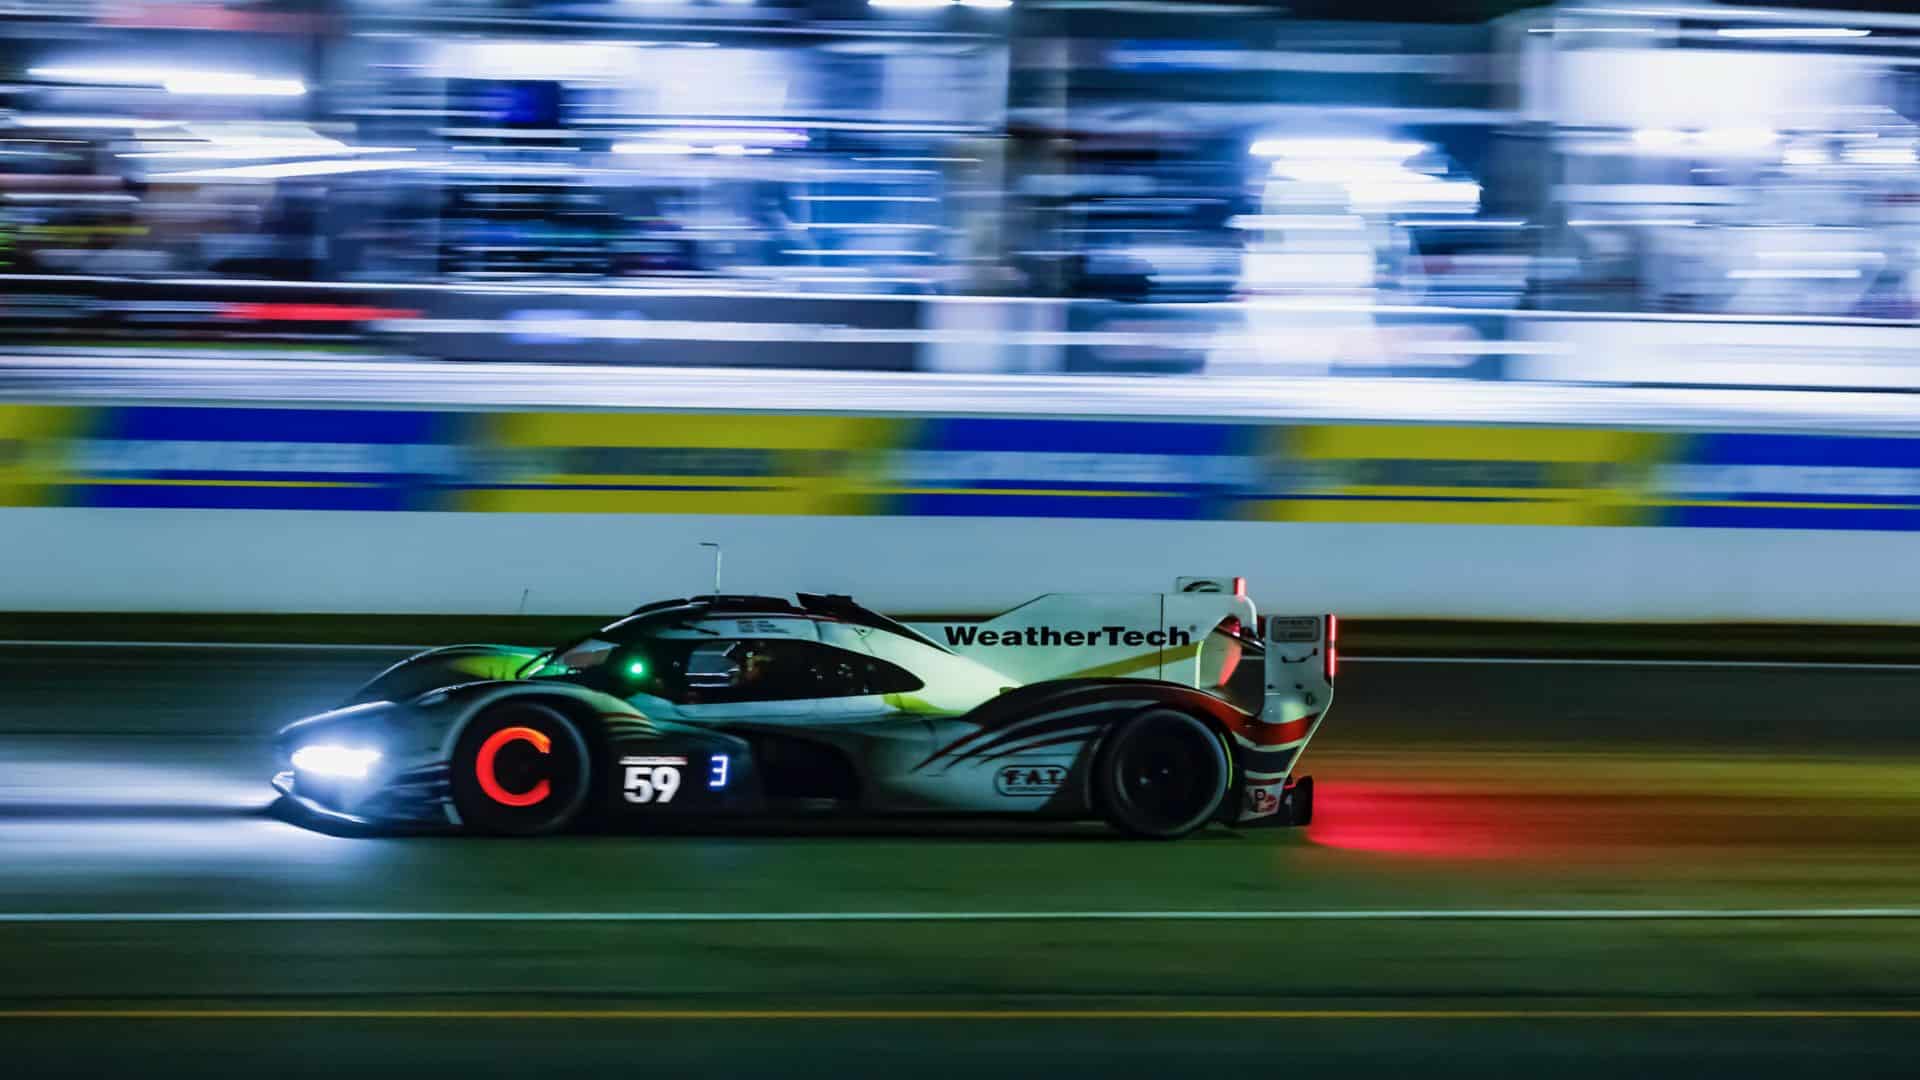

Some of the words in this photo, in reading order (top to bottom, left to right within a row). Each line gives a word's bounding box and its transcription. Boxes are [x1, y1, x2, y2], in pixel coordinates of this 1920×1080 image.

[944, 626, 1190, 646] WeatherTech
[623, 766, 681, 803] 59
[709, 755, 729, 787] 3
